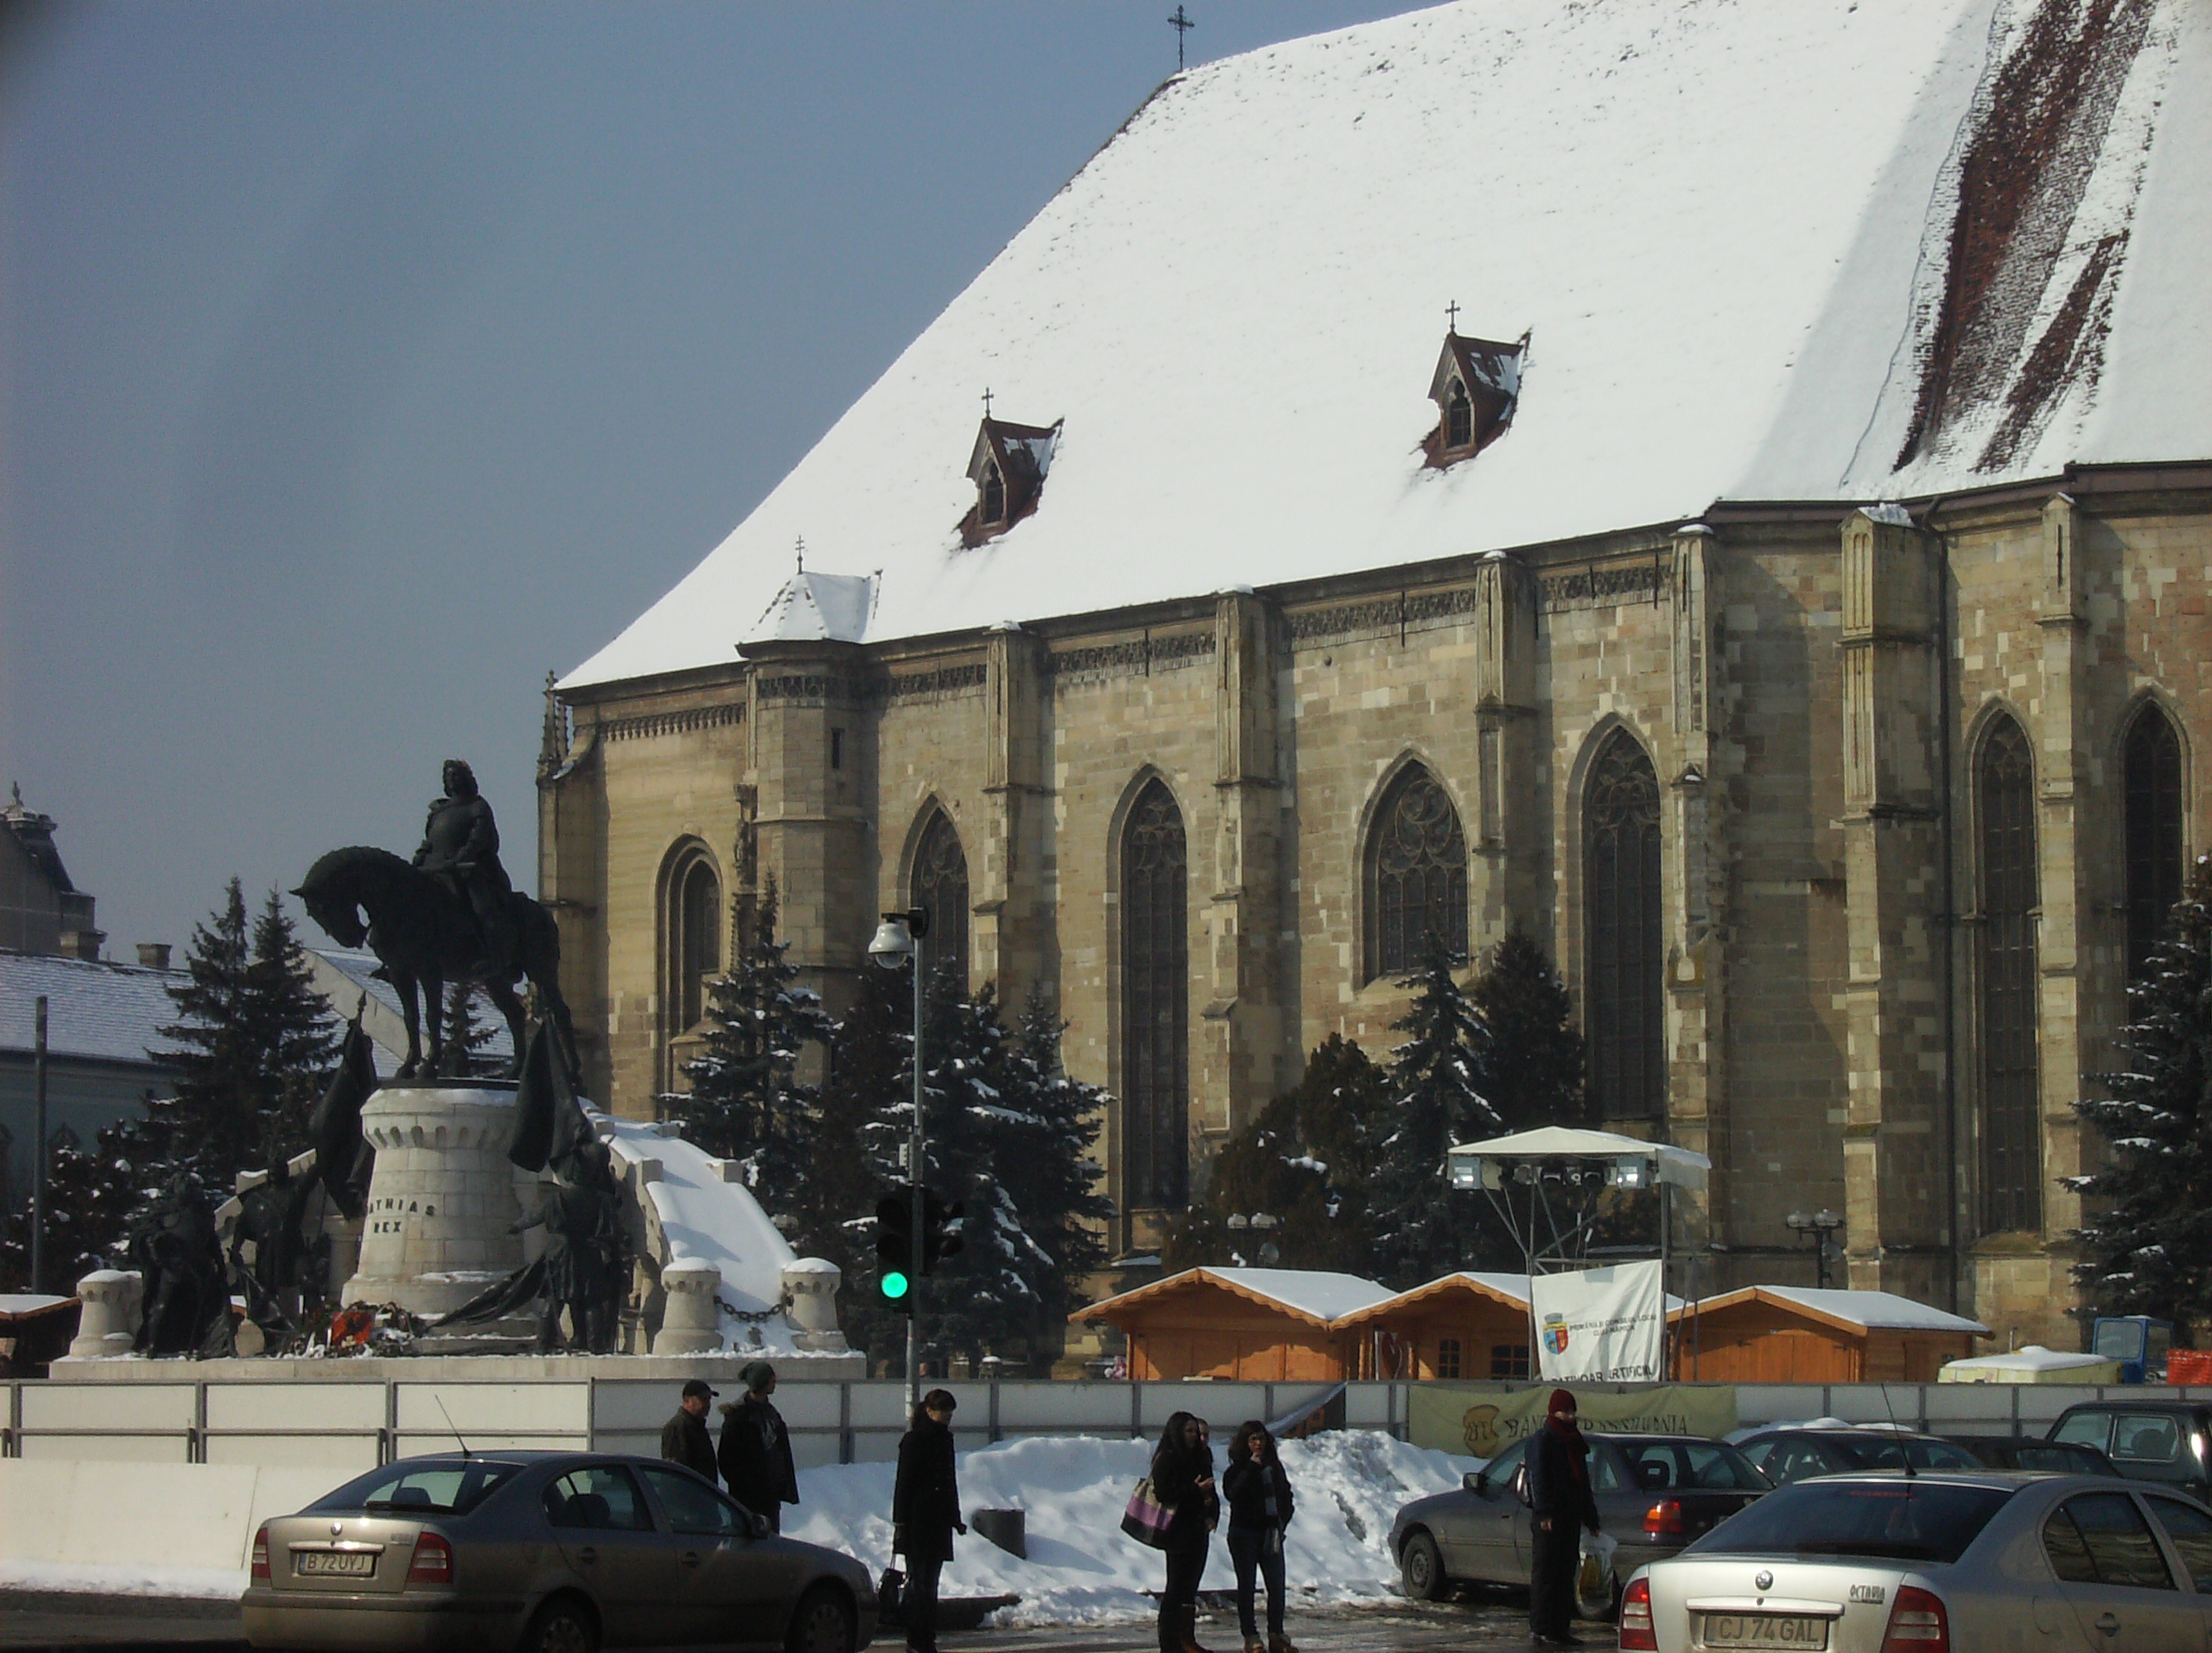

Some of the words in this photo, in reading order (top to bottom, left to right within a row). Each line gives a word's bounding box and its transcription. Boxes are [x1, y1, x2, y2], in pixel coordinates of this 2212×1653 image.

[374, 1221, 402, 1234] REX
[308, 1554, 317, 1569] B
[322, 1554, 336, 1570] 72
[1849, 1584, 1886, 1599] OCTAVIA
[1720, 1617, 1744, 1639] CJ
[1752, 1618, 1776, 1641] 74
[1780, 1619, 1819, 1642] GAL
